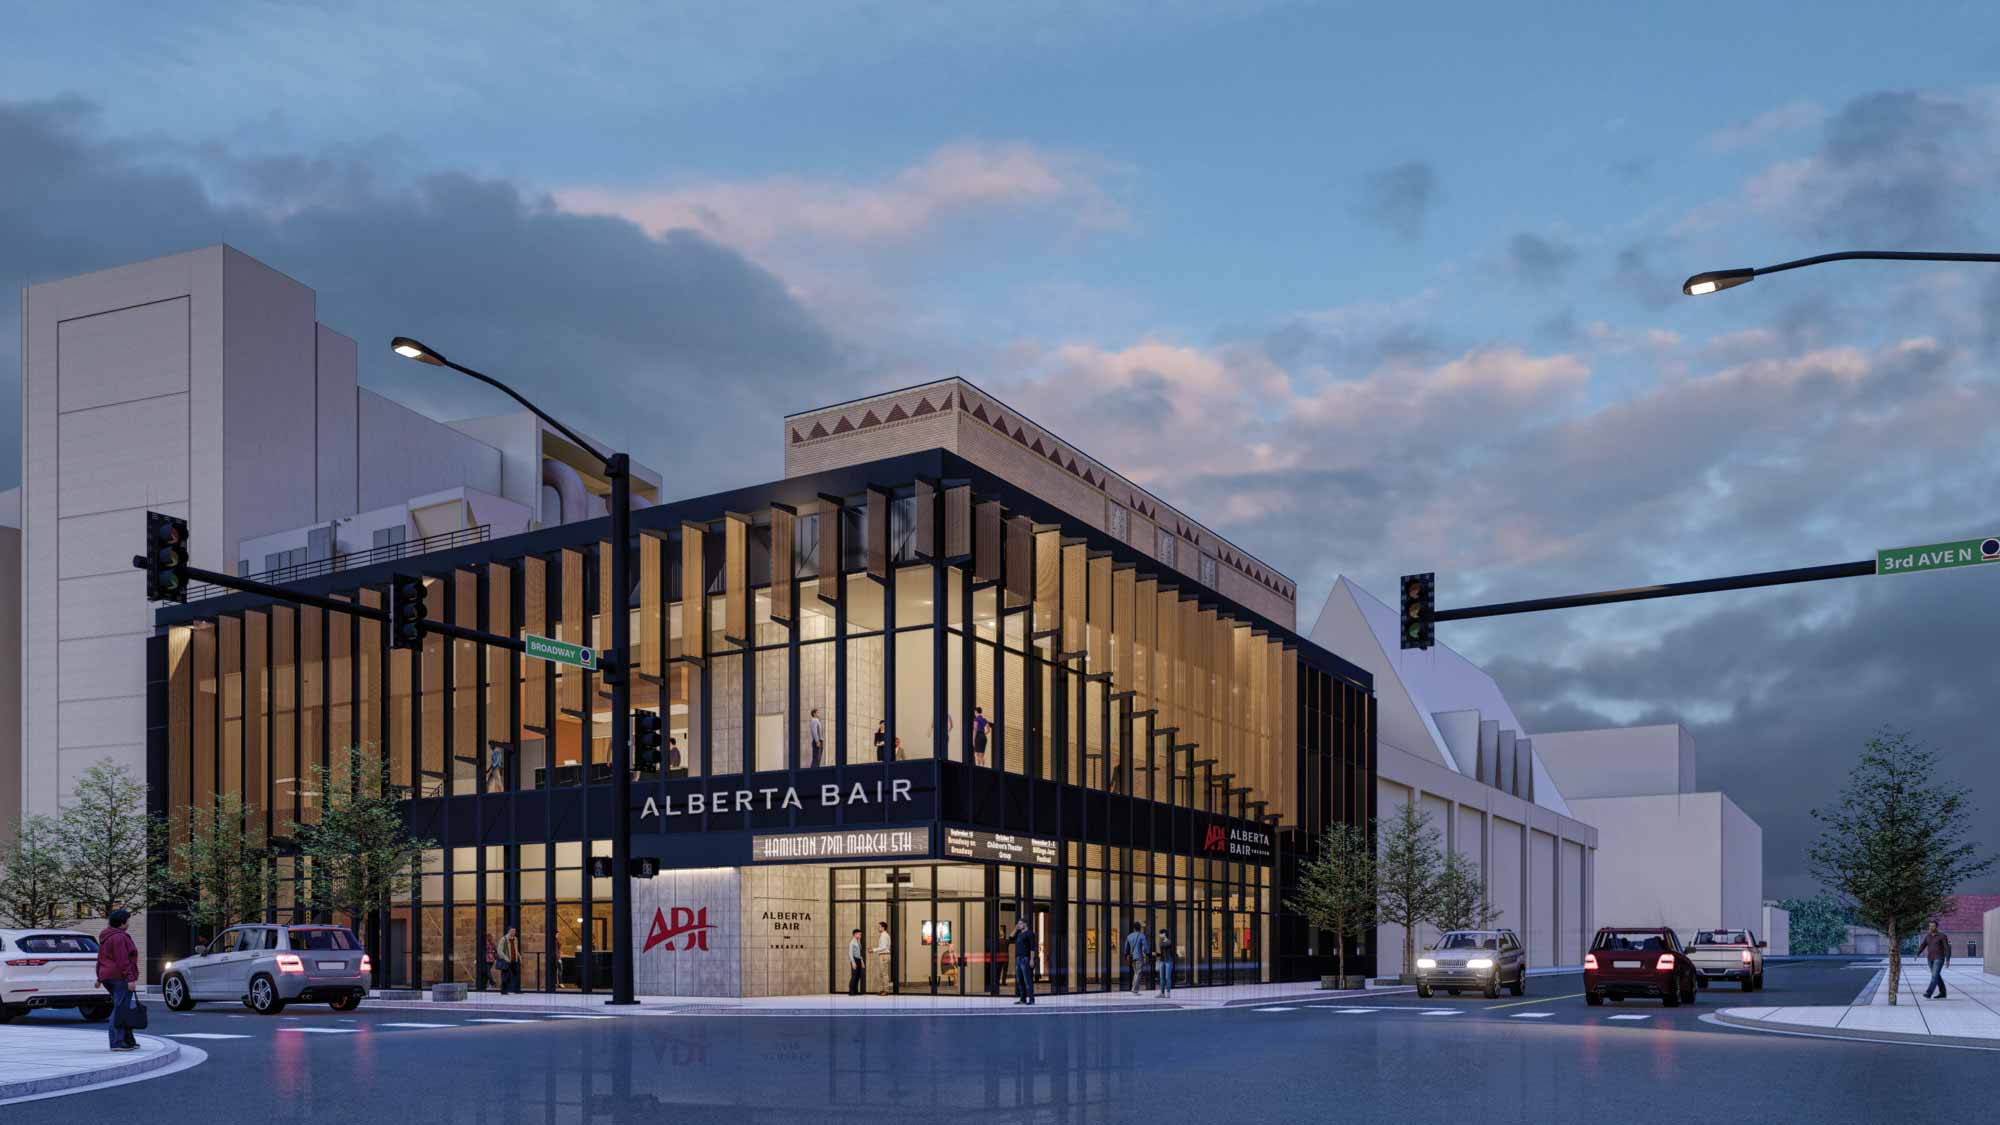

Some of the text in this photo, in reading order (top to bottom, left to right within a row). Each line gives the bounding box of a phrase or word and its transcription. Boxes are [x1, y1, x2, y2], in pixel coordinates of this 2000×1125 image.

[1884, 548, 1971, 569] 3rd AVE N
[531, 641, 576, 659] BROADWAY
[640, 779, 912, 819] ALBERTA BAIR
[764, 831, 912, 857] HAMILTON 7PM MARCH 5TH
[1230, 829, 1270, 846] ALBERTA
[1230, 843, 1251, 856] BAIR
[762, 911, 811, 921] ALBERTA
[774, 922, 800, 931] BAIR
